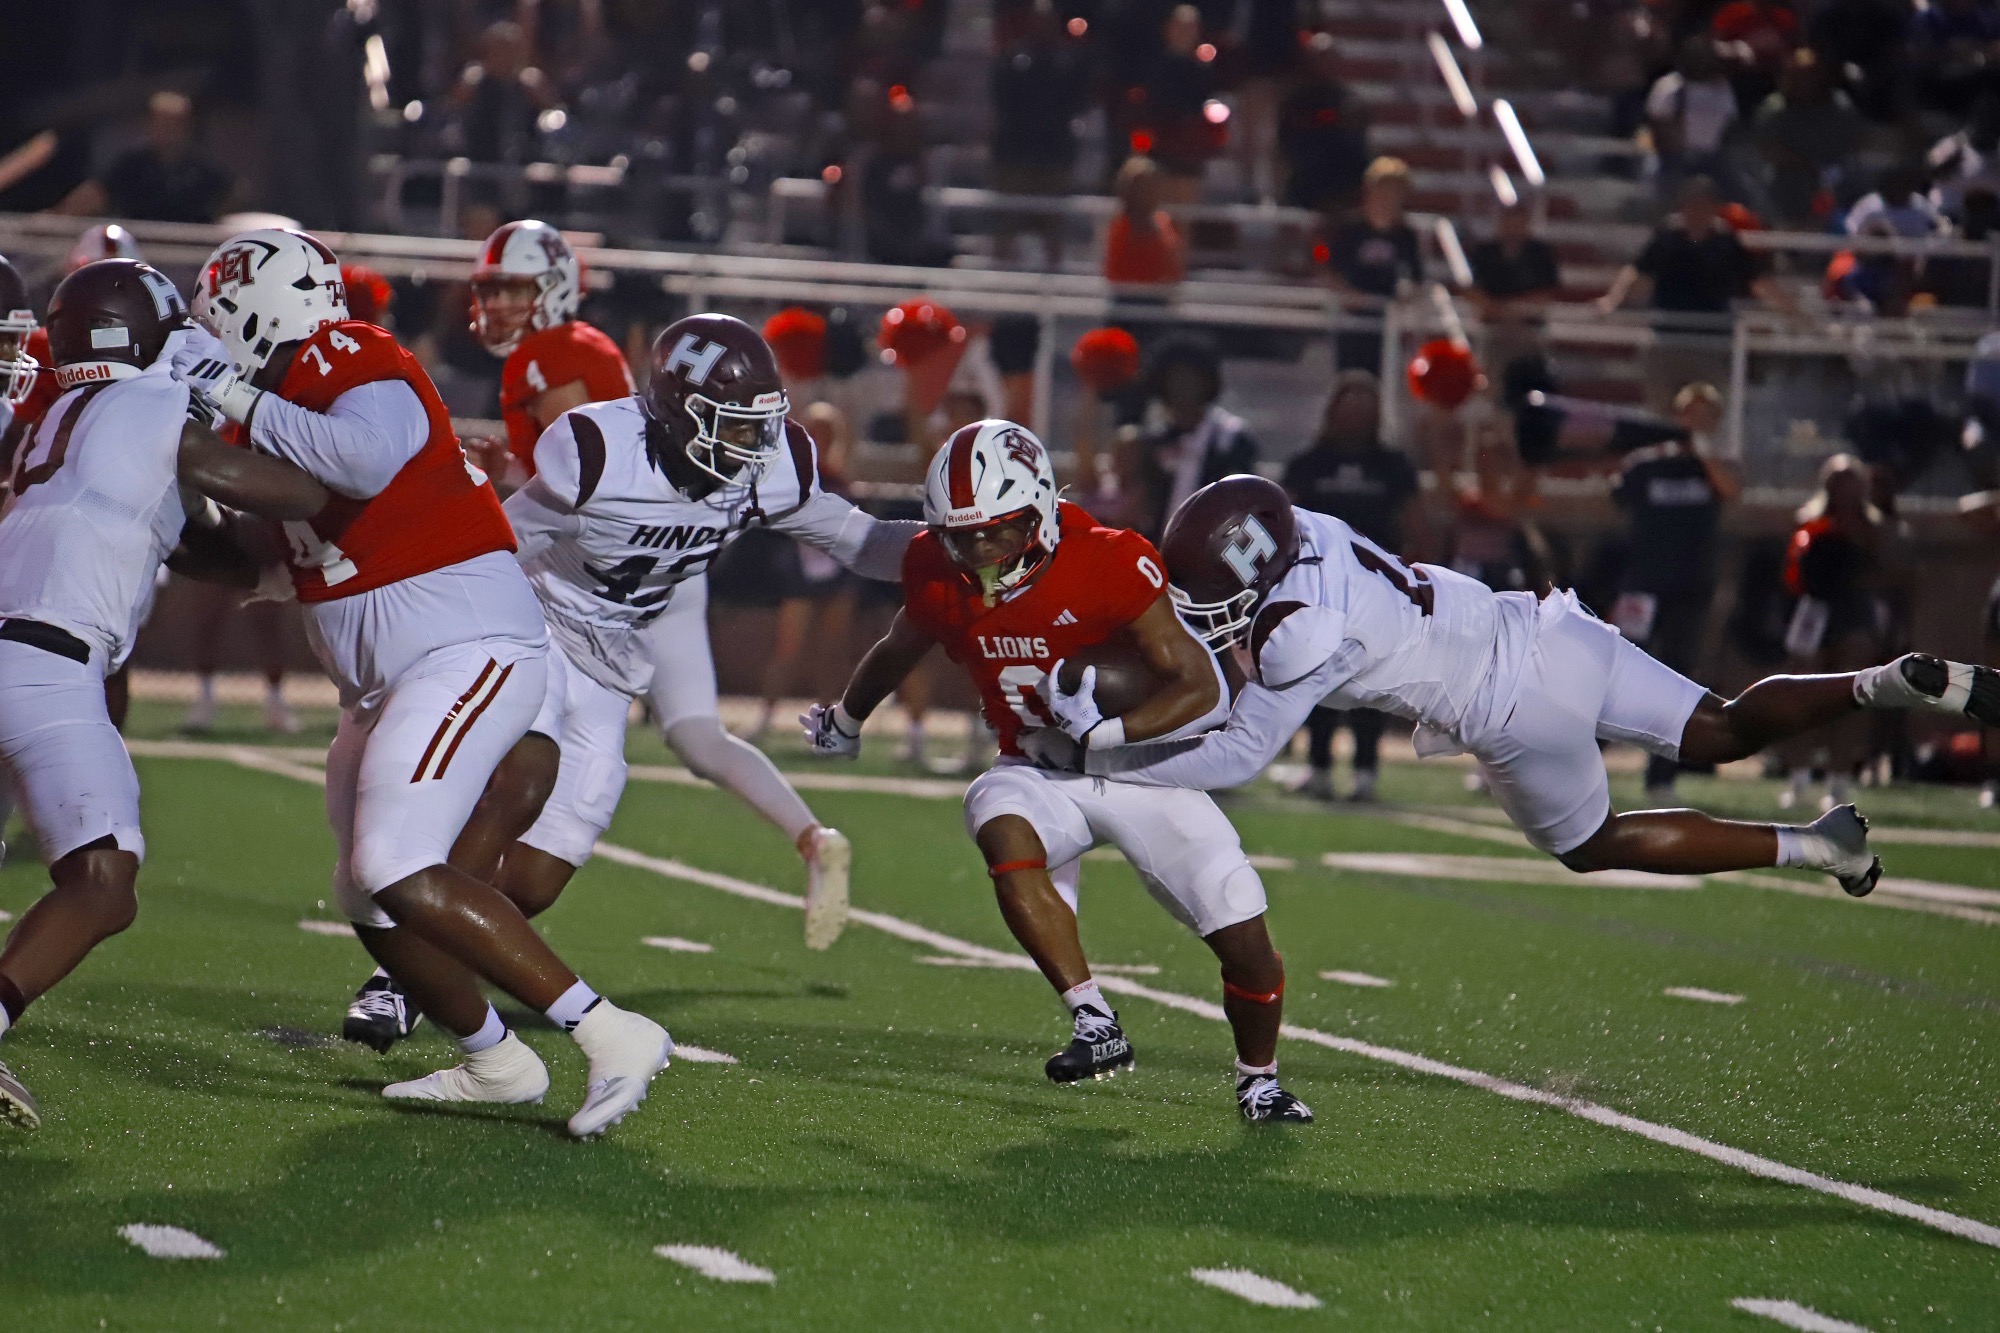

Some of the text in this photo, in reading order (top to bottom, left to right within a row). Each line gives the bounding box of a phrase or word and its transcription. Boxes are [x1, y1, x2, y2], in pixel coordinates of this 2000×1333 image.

[301, 329, 361, 377] 74
[664, 332, 727, 386] H
[56, 364, 111, 385] Riddell
[947, 510, 983, 523] Riddell
[1220, 513, 1278, 588] H
[1136, 555, 1163, 588] 0
[977, 635, 1050, 659] LIONS
